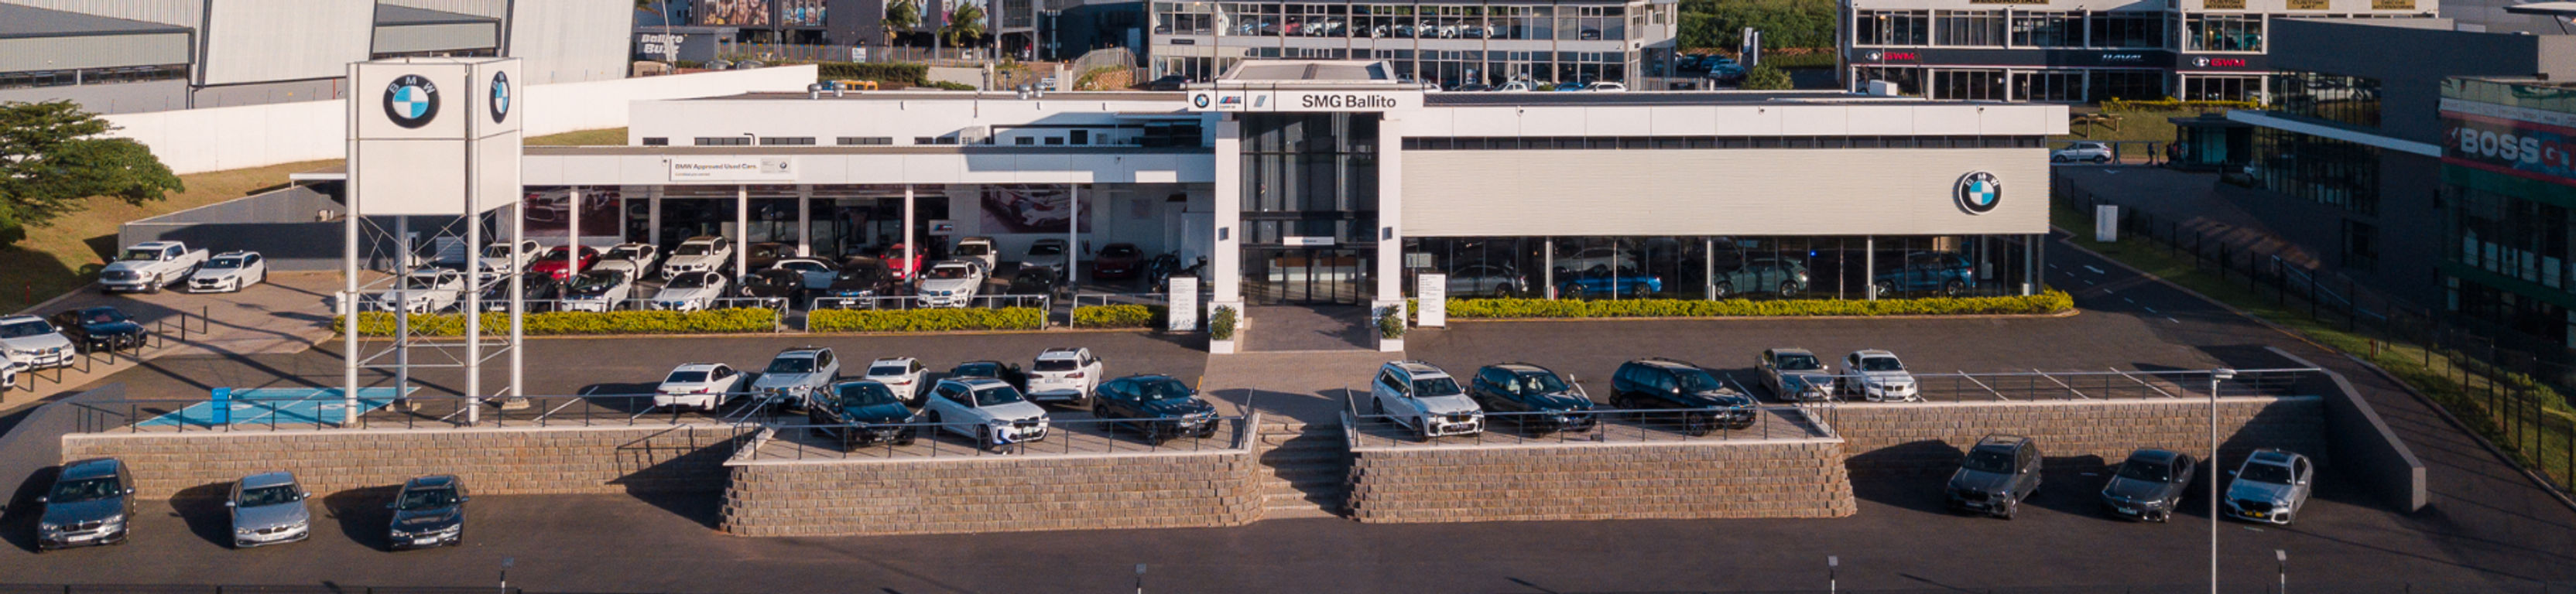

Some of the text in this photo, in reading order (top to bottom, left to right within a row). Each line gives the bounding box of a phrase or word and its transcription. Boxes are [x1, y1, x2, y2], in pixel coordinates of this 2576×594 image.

[1884, 51, 1915, 60] GWM
[2211, 57, 2245, 67] GWM
[389, 77, 435, 94] BMW
[1302, 94, 1396, 108] SMG Ballito
[1965, 172, 1999, 187] BMW
